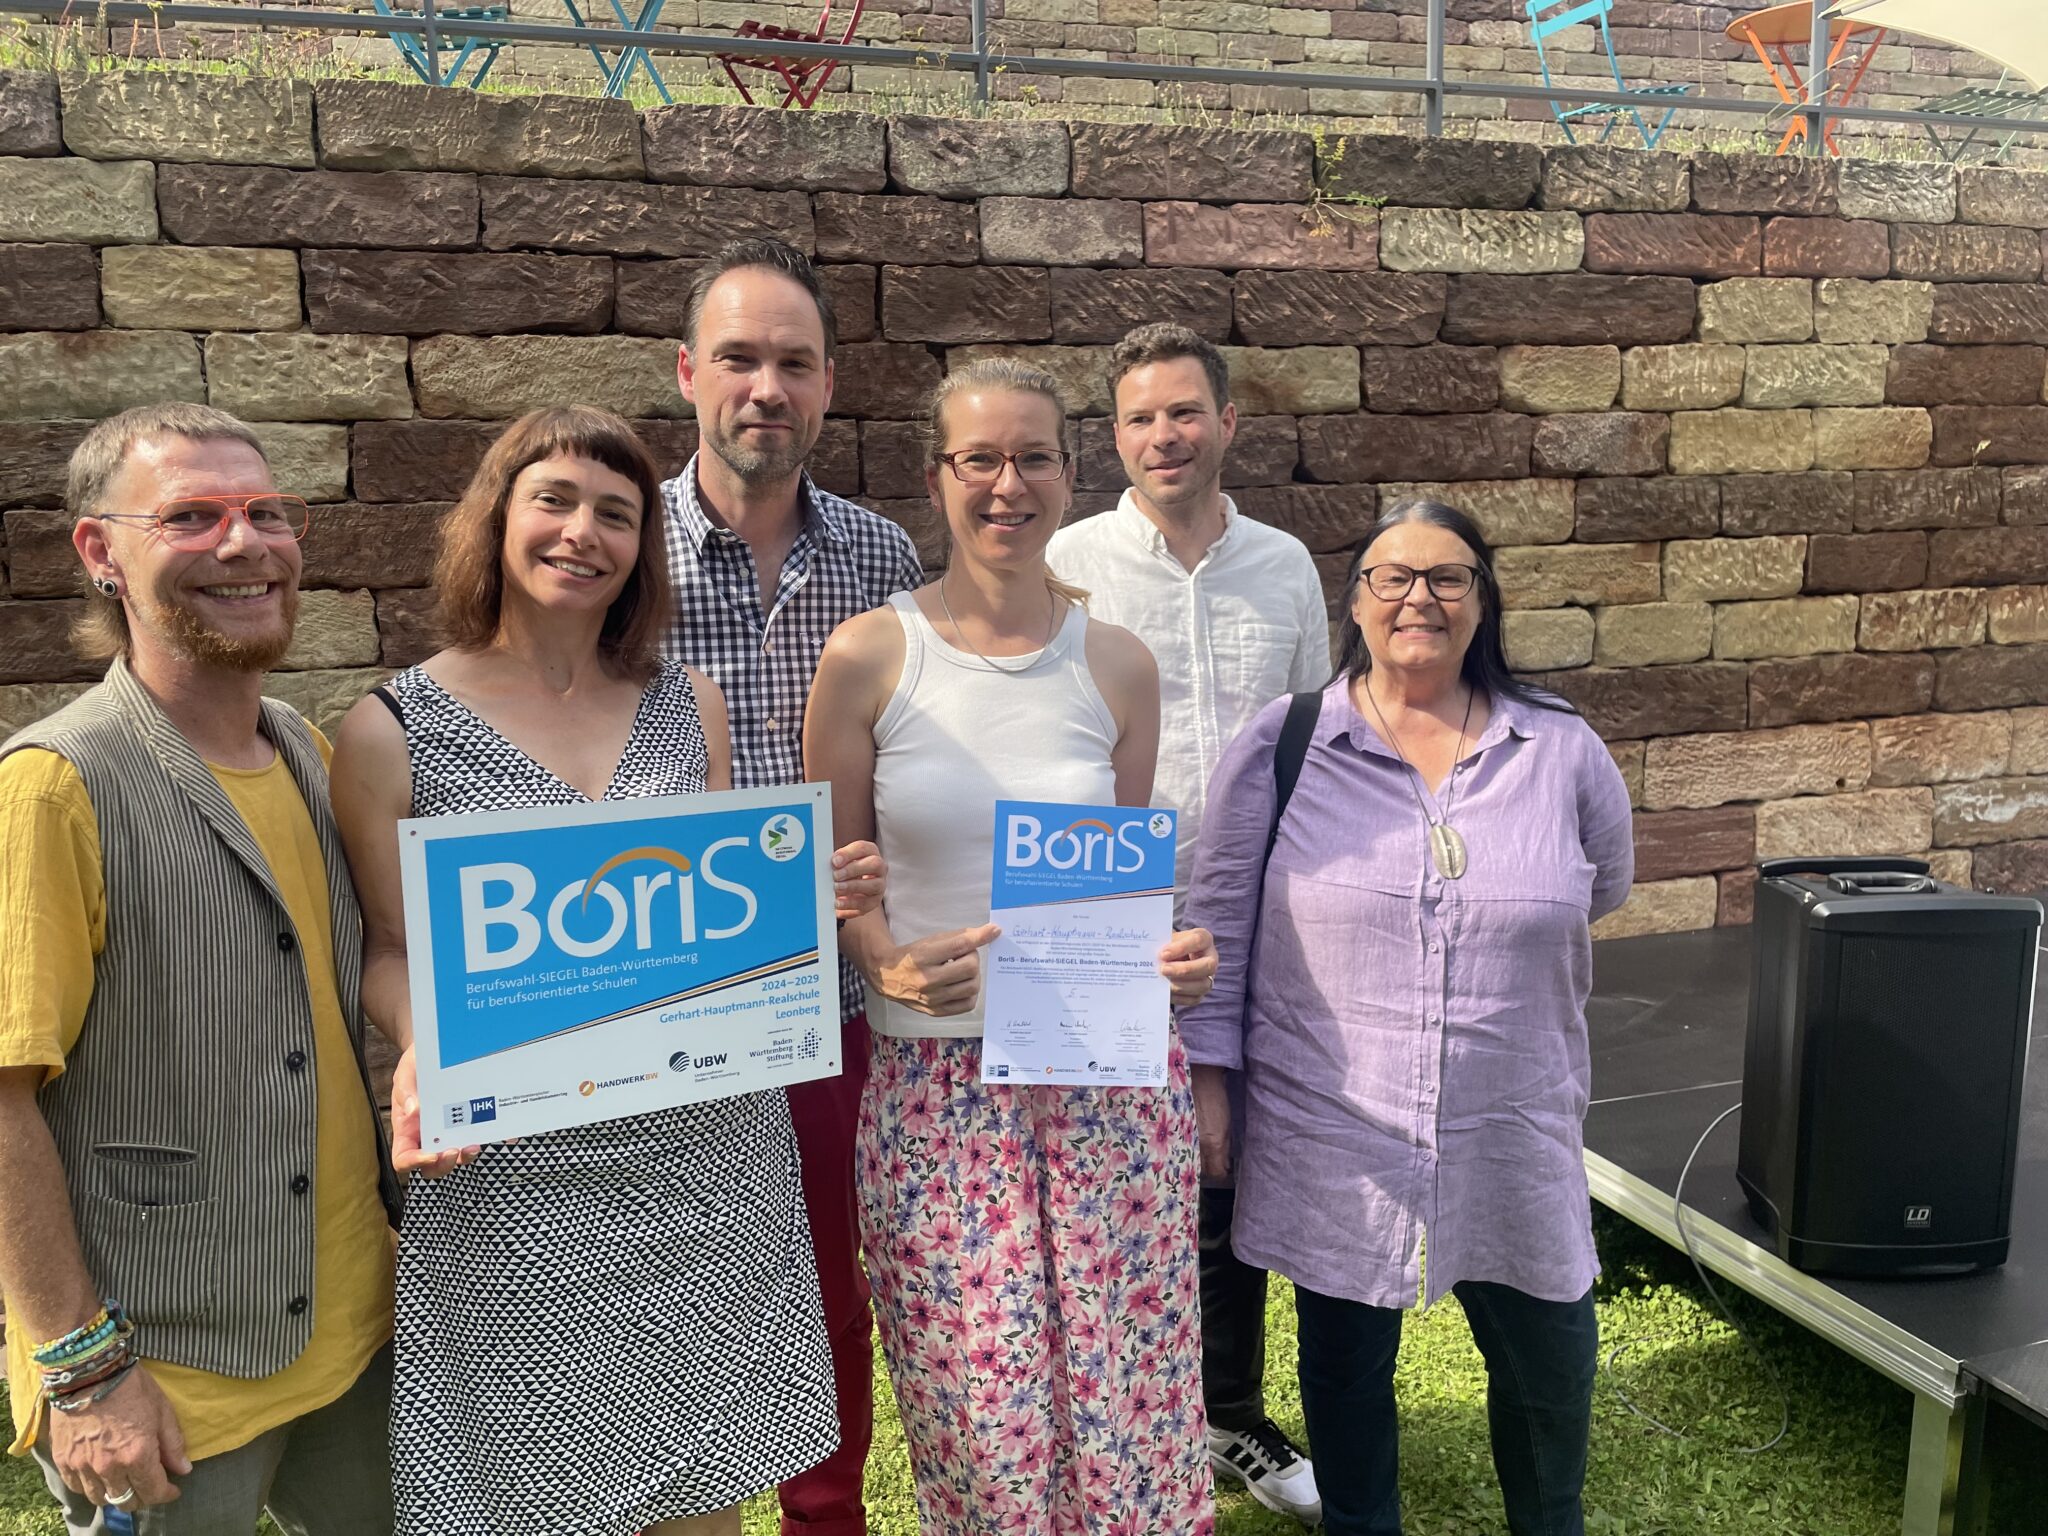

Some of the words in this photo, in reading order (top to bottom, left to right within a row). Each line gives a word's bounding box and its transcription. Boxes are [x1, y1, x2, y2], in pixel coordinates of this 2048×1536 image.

[1006, 814, 1145, 873] BoriS
[459, 836, 758, 974] BoriS
[466, 970, 579, 994] Berufswahl-SIEGEL
[581, 952, 699, 978] Baden-Württemberg
[467, 998, 485, 1010] für
[488, 981, 590, 1008] berufsorientierte
[592, 976, 638, 993] Schulen
[659, 988, 821, 1024] Gerhart-Hauptmann-Realschule
[775, 1004, 822, 1020] Leonberg
[772, 1037, 793, 1047] Baden
[749, 1045, 794, 1058] Württemberg
[766, 1052, 794, 1063] Stiftung
[693, 1052, 728, 1069] UBW
[472, 1100, 494, 1113] IHK
